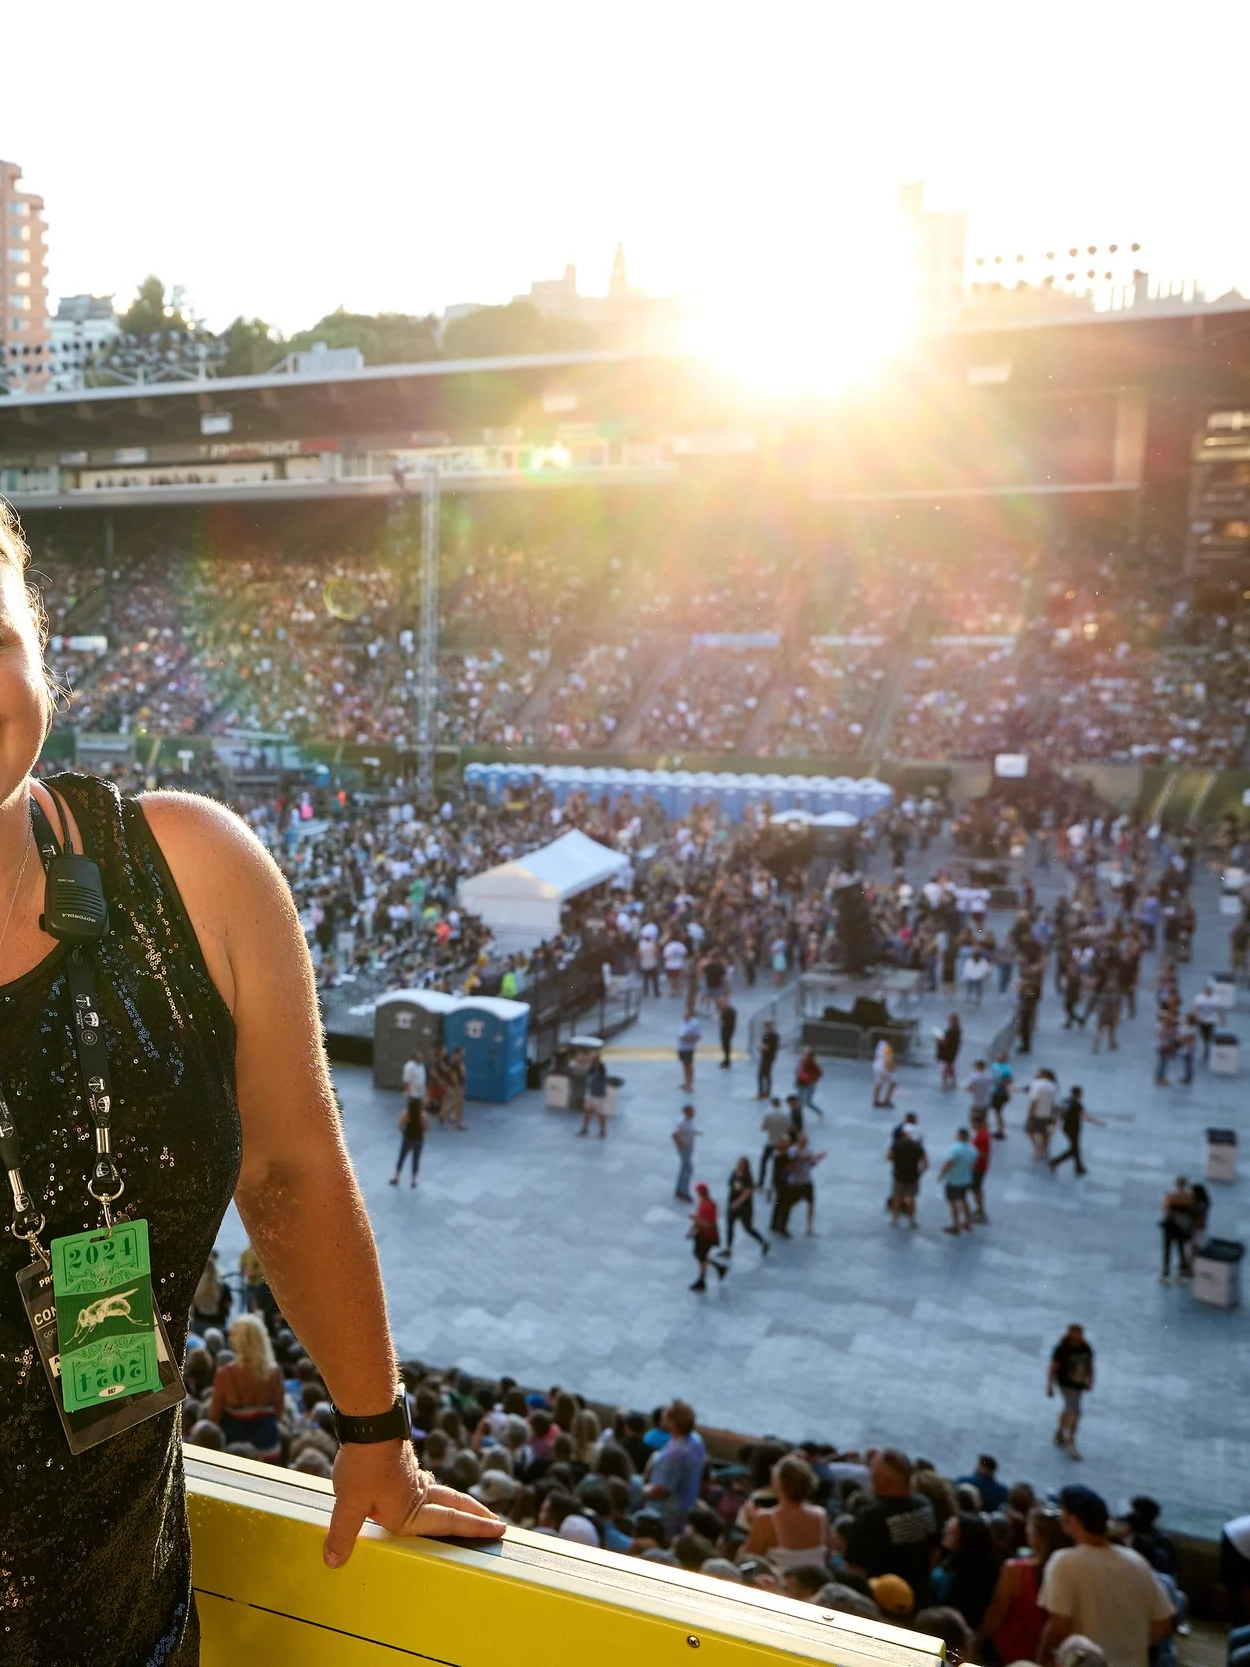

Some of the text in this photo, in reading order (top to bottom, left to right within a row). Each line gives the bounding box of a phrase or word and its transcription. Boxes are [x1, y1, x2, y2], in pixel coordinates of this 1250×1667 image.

[62, 913, 96, 923] MOTOROLA
[69, 1237, 132, 1269] 2024
[80, 1359, 142, 1393] 2024
